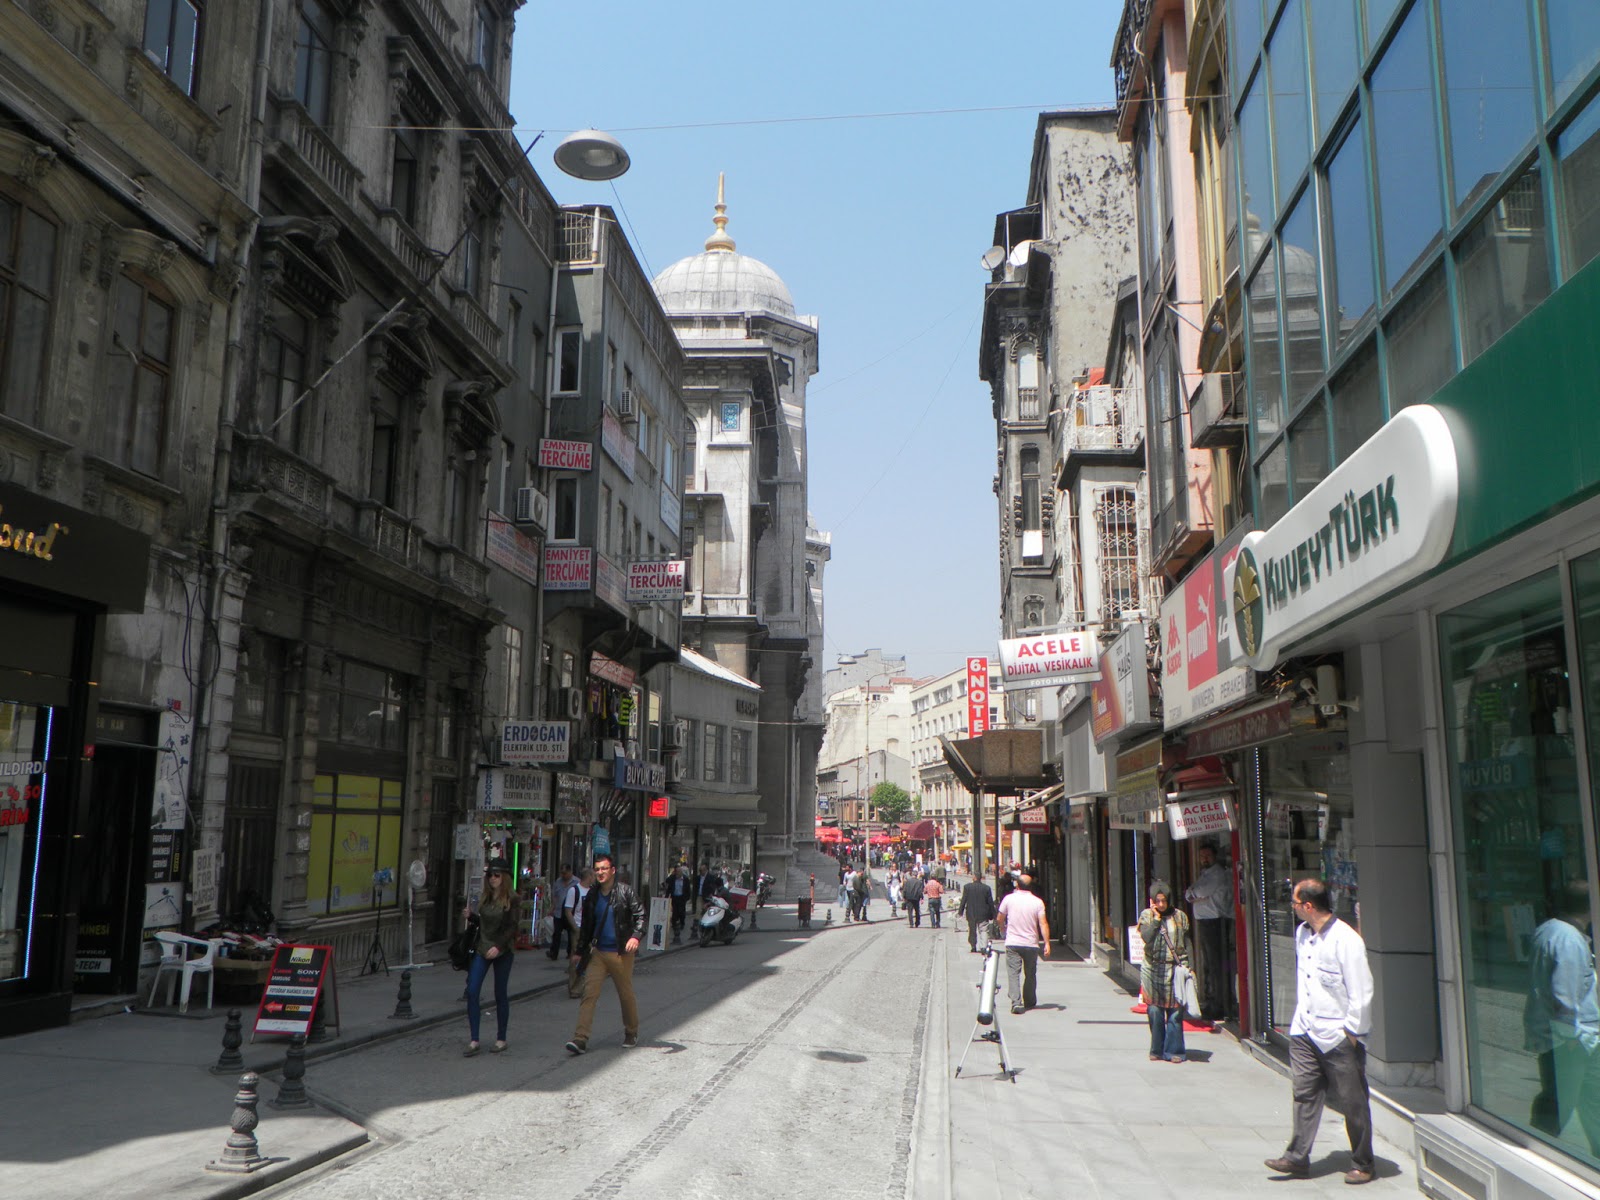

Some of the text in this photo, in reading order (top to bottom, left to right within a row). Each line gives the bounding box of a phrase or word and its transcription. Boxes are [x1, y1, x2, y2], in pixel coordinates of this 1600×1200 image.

[544, 440, 588, 452] EMNİYET
[541, 450, 591, 468] TERCÜME
[546, 548, 590, 560] EMNİYET
[546, 561, 590, 581] TERCÜME
[632, 562, 679, 573] EMNİYET
[630, 573, 682, 588] TERCÜME
[1018, 638, 1080, 657] ACELE
[1008, 657, 1093, 676] DİJİTAL VESİKALIK
[1030, 676, 1076, 687] FOTO HALİS
[971, 675, 985, 738] NOTE
[504, 724, 566, 742] ERDOĞAN
[504, 743, 533, 752] ELEKTRİK
[536, 743, 550, 752] LTD.
[504, 774, 543, 790] ERDOĞAN
[1183, 802, 1221, 816] ACELE
[197, 855, 213, 871] BOX
[197, 871, 212, 888] FOR
